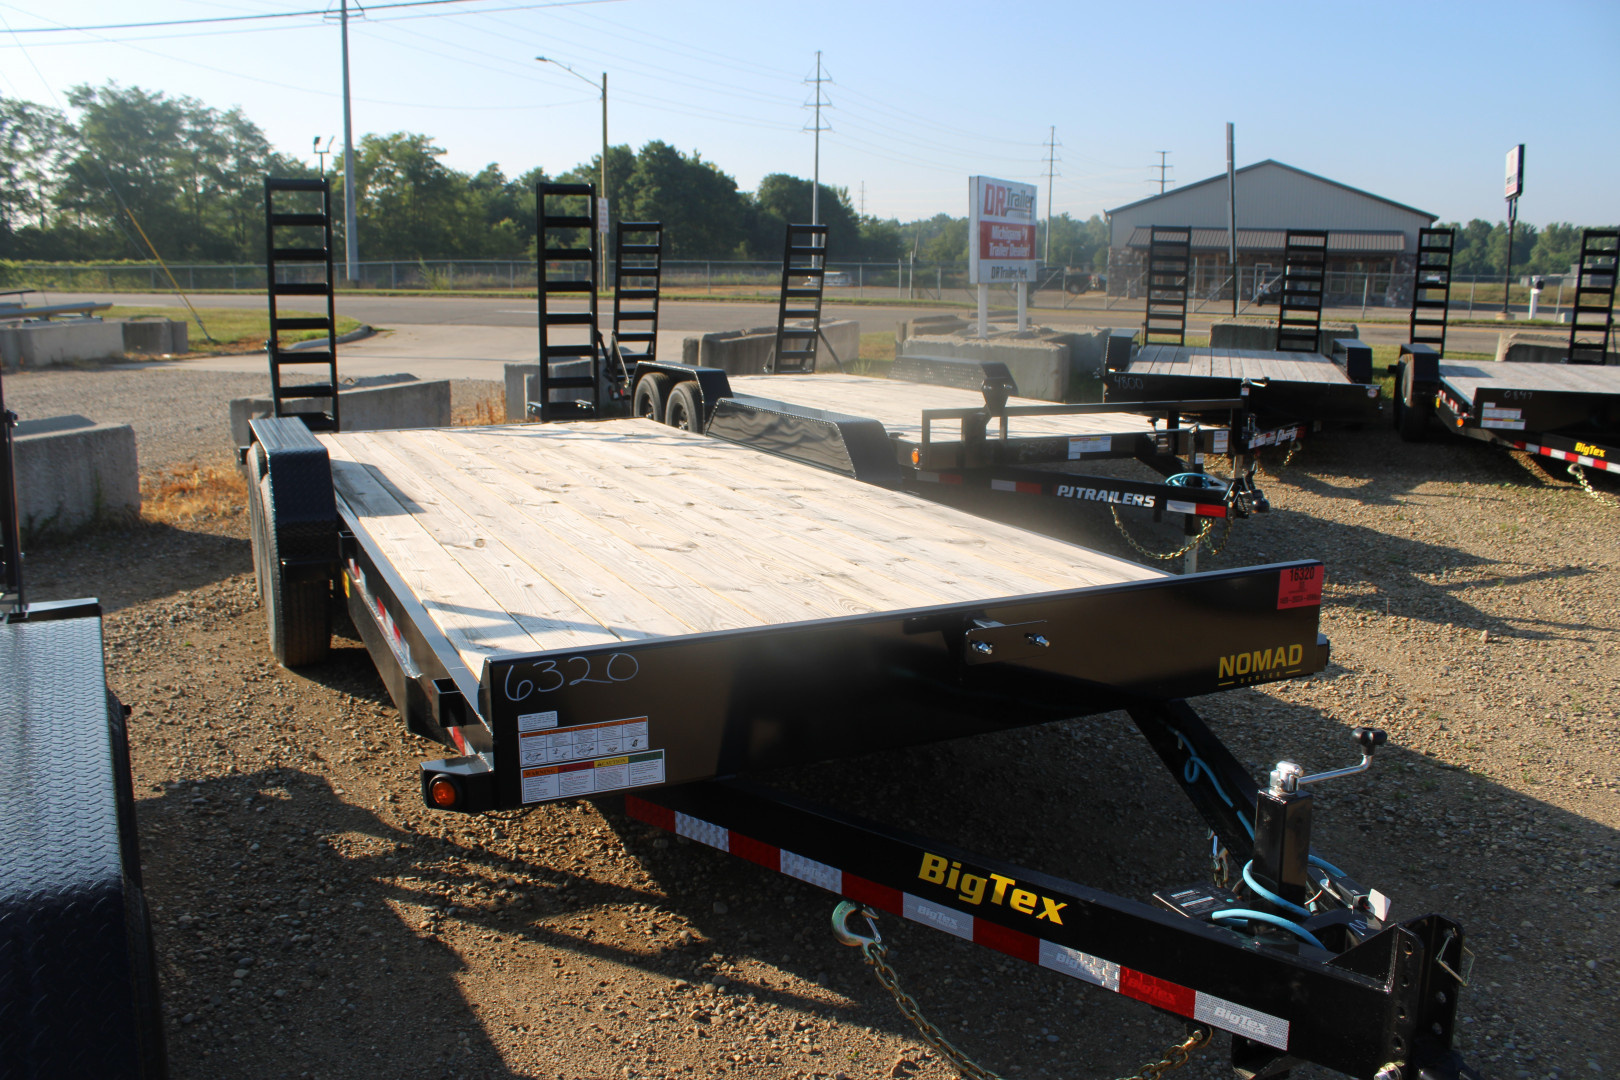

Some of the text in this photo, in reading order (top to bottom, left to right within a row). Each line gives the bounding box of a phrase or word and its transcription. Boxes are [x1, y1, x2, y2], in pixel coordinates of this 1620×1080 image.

[983, 183, 1034, 217] DR Trailer
[1574, 442, 1606, 458] BigTex
[1290, 566, 1315, 582] 16320
[1218, 644, 1303, 679] NOMAD
[504, 653, 639, 701] 6320
[525, 768, 556, 777] WARNING
[918, 852, 1068, 925] BigTex
[917, 905, 958, 926] BigTex
[1127, 978, 1176, 1004] BigTex
[1214, 1006, 1267, 1032] BigTex
